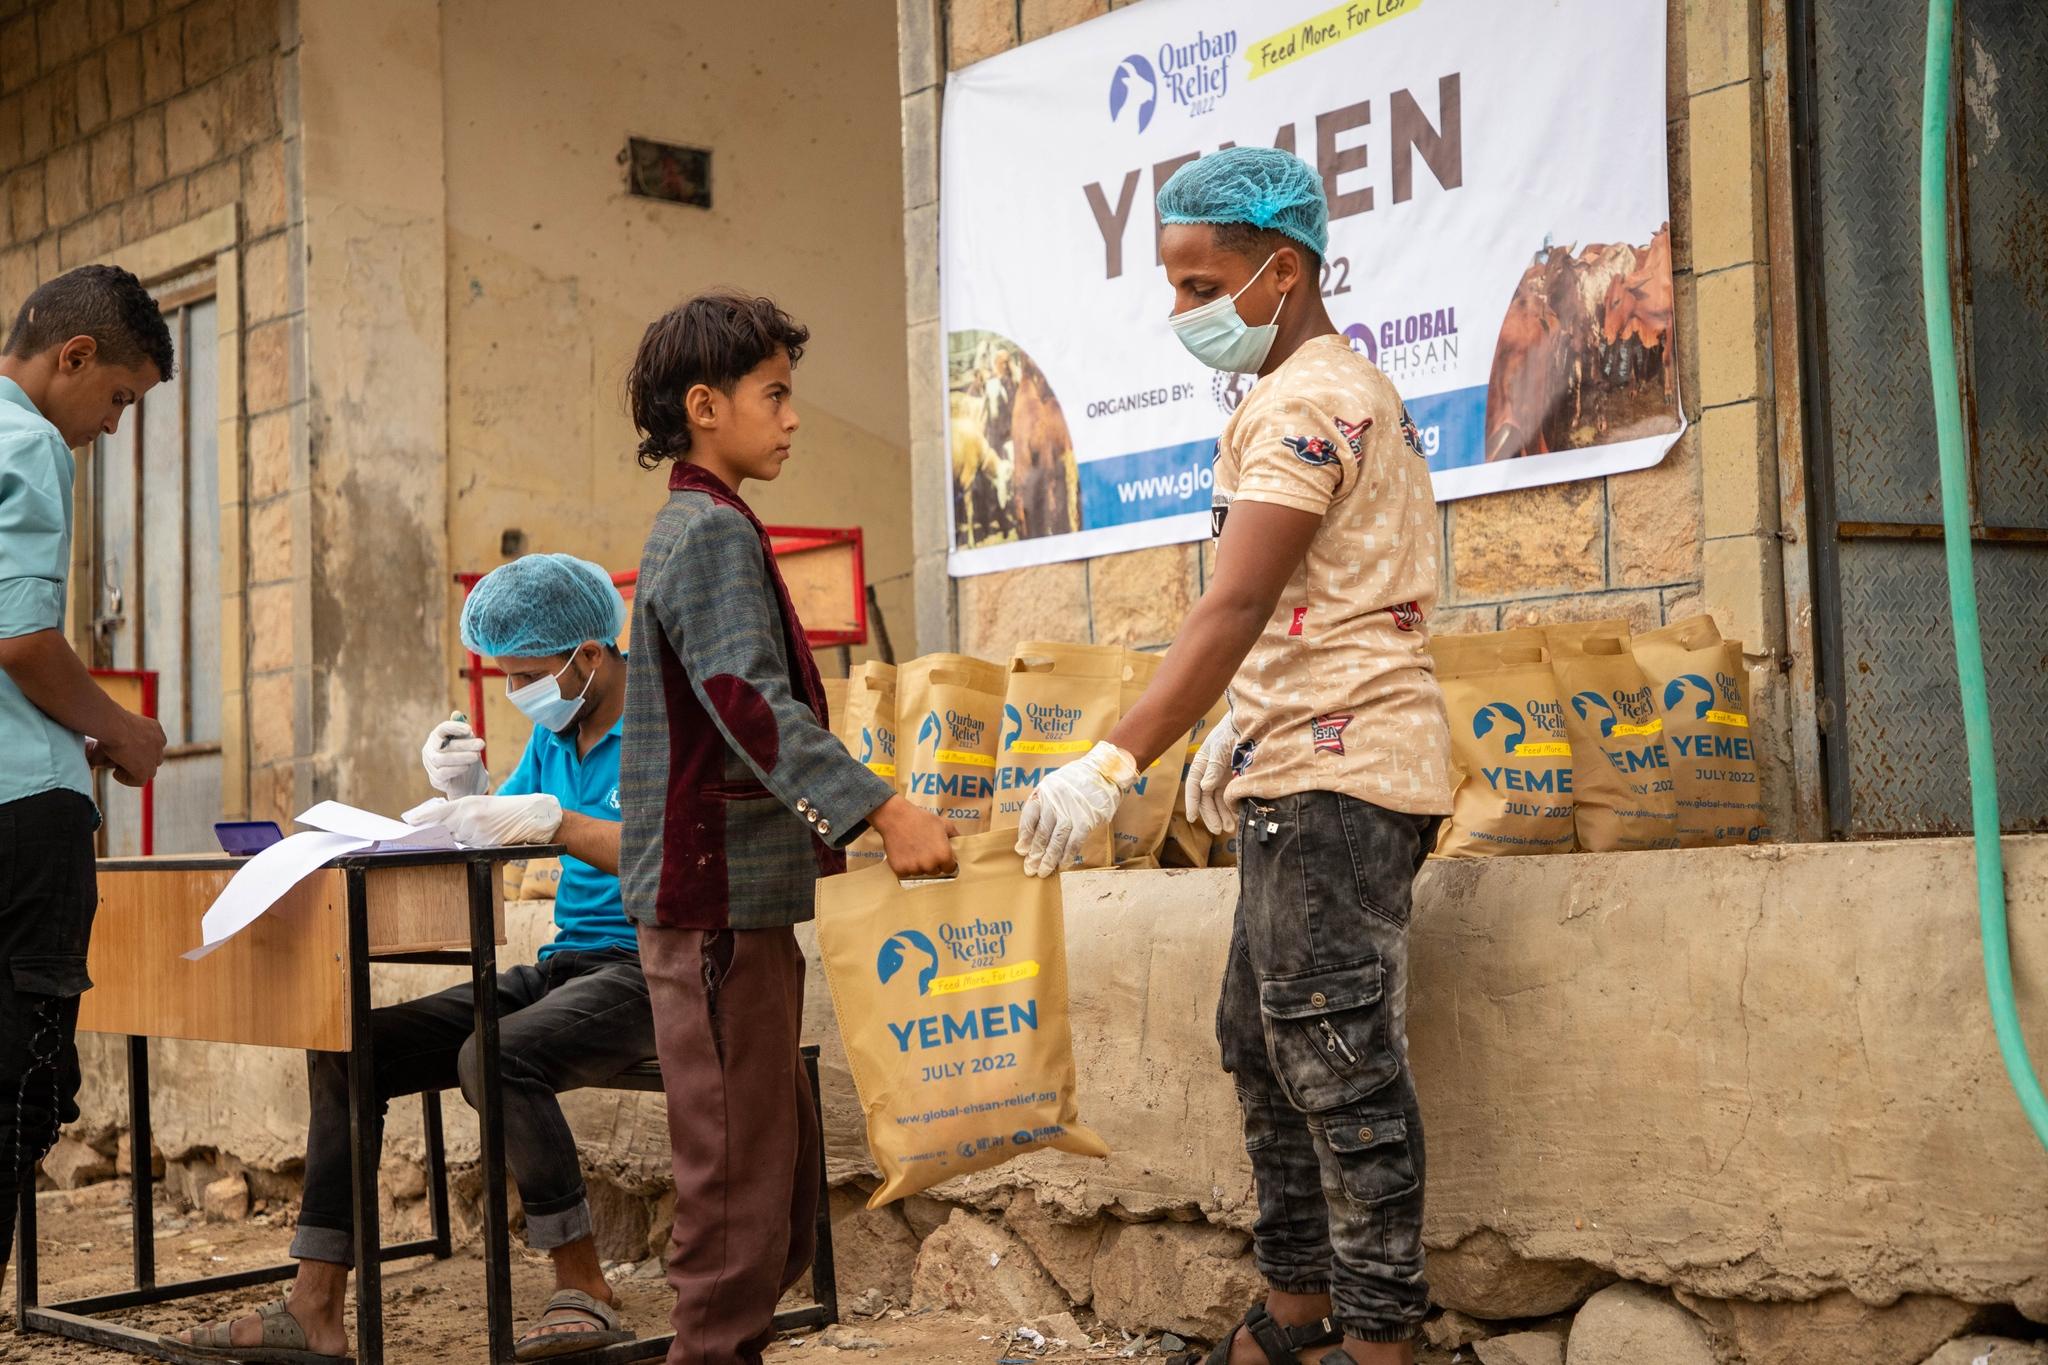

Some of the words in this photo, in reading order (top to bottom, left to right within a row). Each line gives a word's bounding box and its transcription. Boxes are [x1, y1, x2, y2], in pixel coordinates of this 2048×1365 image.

[1261, 34, 1296, 68] Feed
[1301, 24, 1341, 51] More,
[1346, 4, 1372, 30] For
[1159, 29, 1237, 78] Qurban
[1164, 54, 1231, 106] Relief
[1083, 71, 1463, 280] YEN
[1380, 306, 1459, 350] GLOBAL
[1380, 336, 1458, 374] EHSAN
[1086, 388, 1169, 419] ORGANISED
[1171, 382, 1195, 402] BY:
[946, 710, 985, 732] Qurban
[1026, 702, 1082, 720] Qurban
[949, 724, 980, 745] Relief
[1030, 716, 1074, 735] Relief
[1045, 732, 1063, 740] 2022
[1695, 769, 1727, 781] JULY
[1728, 771, 1756, 783] 2022
[947, 808, 980, 819] 2022
[1000, 801, 1024, 813] JULY
[1504, 802, 1541, 817] JULY
[938, 918, 1013, 945] Qurban
[944, 934, 1006, 962] Relief
[971, 956, 995, 969] 2022
[937, 979, 960, 991] Feed
[888, 999, 1038, 1052] YEMEN
[922, 1061, 965, 1082] JULY
[971, 1053, 1017, 1074] 2022
[896, 1091, 1057, 1126] www.global-ehsan-relief.org
